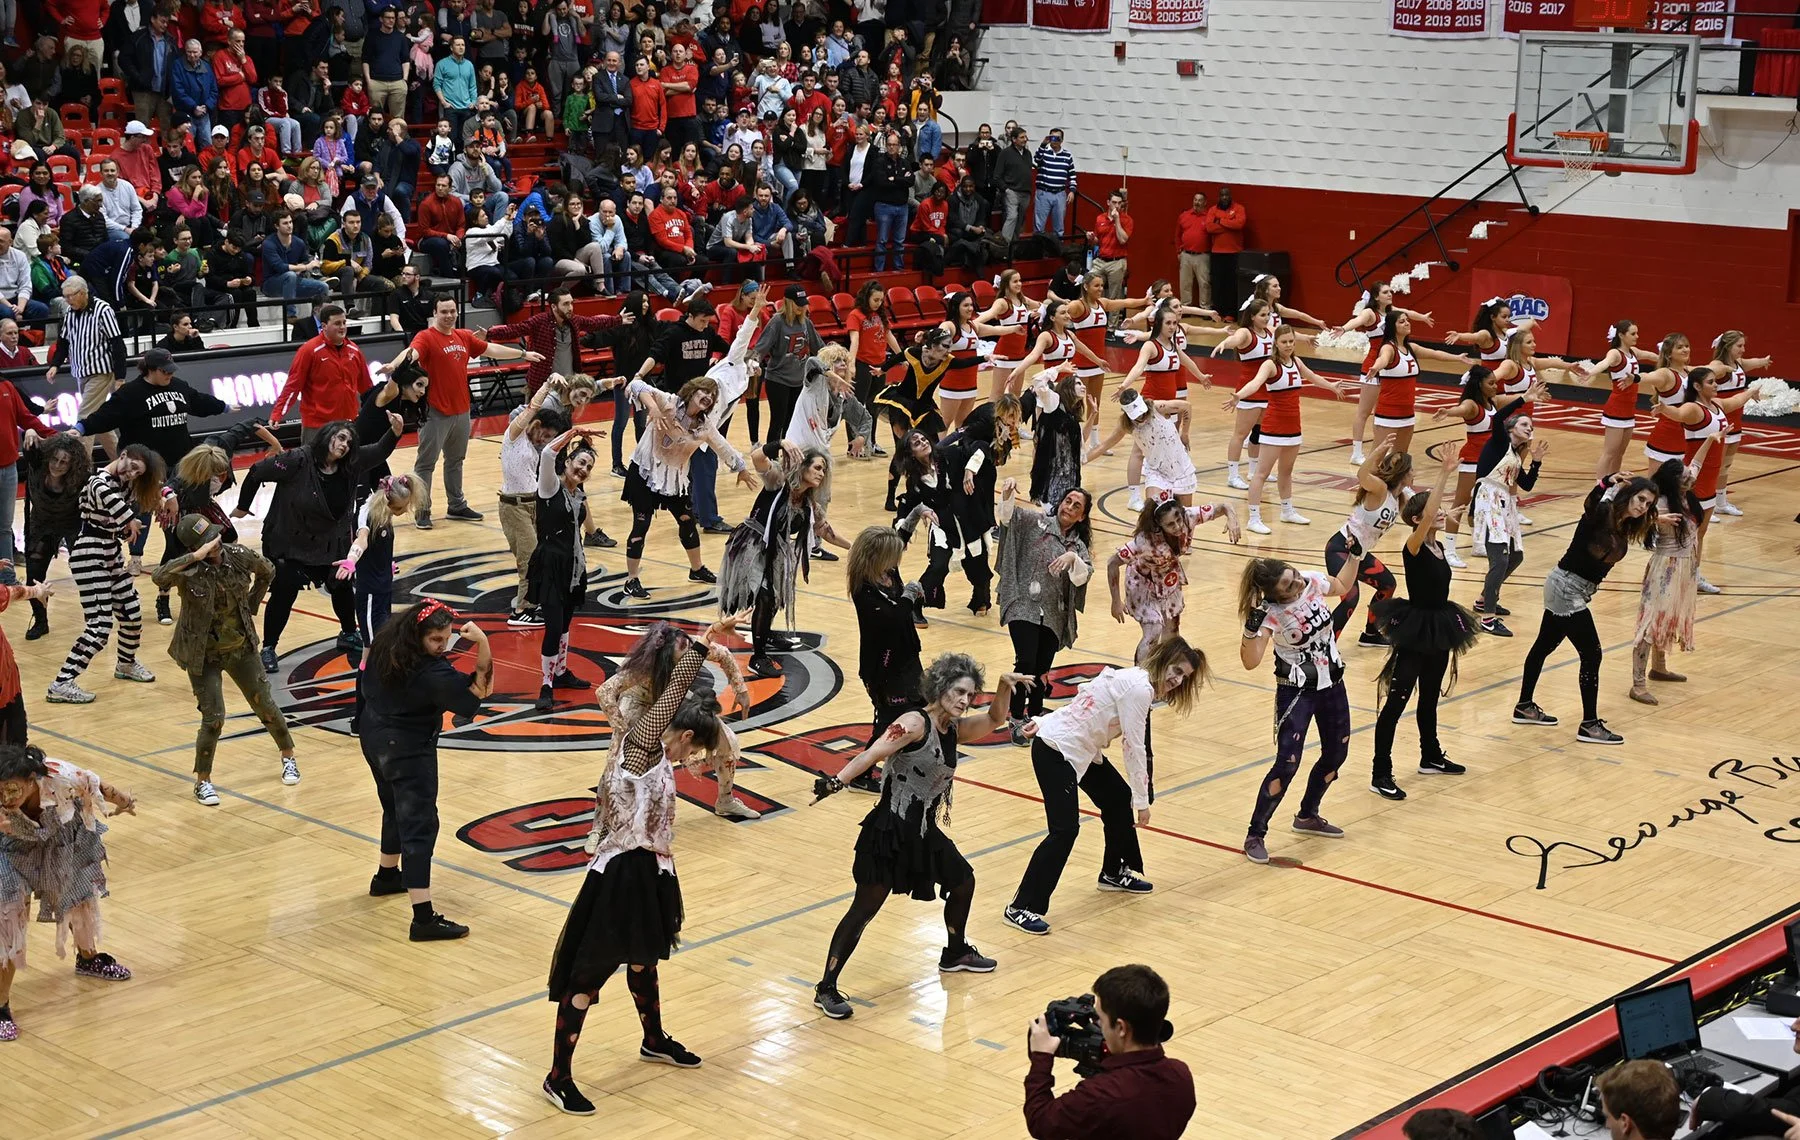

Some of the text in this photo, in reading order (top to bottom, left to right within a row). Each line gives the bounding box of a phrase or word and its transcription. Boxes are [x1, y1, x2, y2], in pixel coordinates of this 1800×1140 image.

[1396, 0, 1422, 10] 2007
[1508, 0, 1566, 15] 2016 2017
[1696, 2, 1724, 12] 2012
[1130, 10, 1152, 21] 2004
[1156, 12, 1181, 22] 2005
[1396, 14, 1482, 26] 2012 2013 2015
[1694, 18, 1724, 30] 2016
[1016, 310, 1027, 322] F
[1094, 312, 1105, 325] F
[967, 337, 978, 350] F
[1063, 344, 1074, 357] F
[1168, 355, 1178, 369] F
[1407, 360, 1416, 374] F
[1631, 362, 1639, 374] F
[1287, 372, 1298, 386] F
[1735, 372, 1746, 388] F
[152, 412, 188, 428] UNIVERSIT
[1294, 600, 1320, 625] NO
[1282, 606, 1332, 646] DOUB
[1119, 876, 1132, 887] N
[1015, 914, 1027, 925] N
